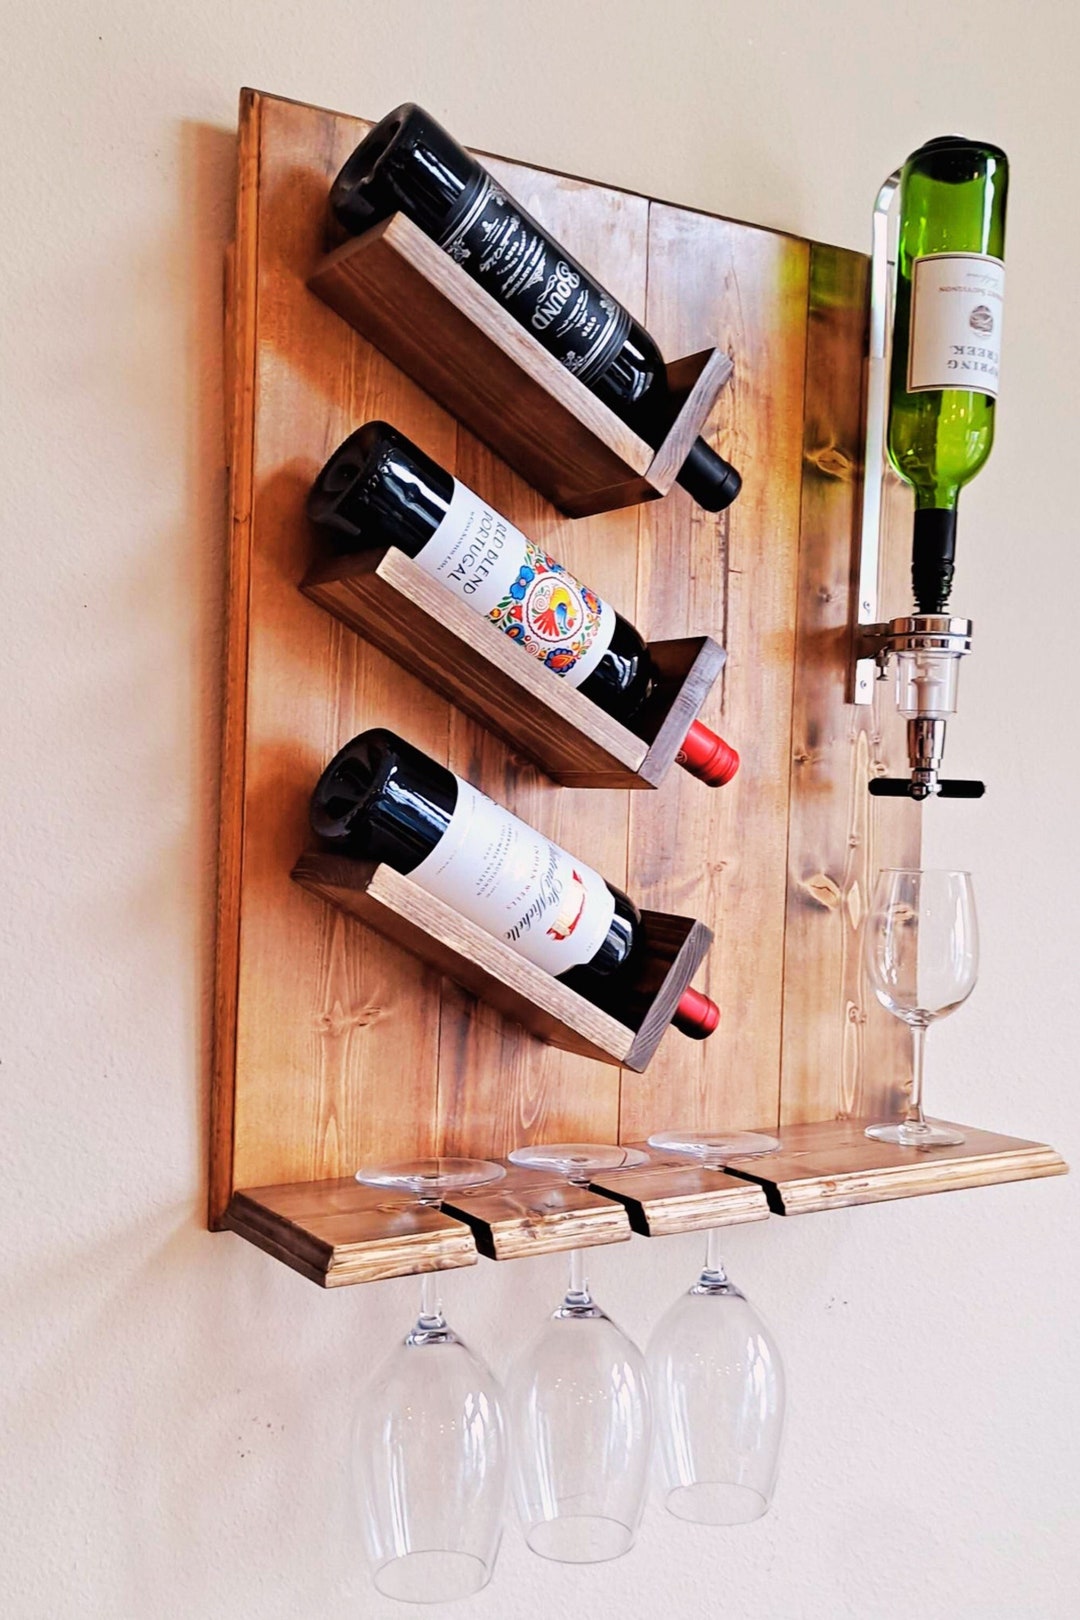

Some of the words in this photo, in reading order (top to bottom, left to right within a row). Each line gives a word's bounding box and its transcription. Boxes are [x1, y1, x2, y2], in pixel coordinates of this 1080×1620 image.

[529, 261, 579, 330] BOUND
[447, 510, 492, 581] PORTUGAL
[491, 521, 506, 550] RED
[462, 549, 498, 594] BLEND
[502, 873, 546, 941] Michelle
[504, 884, 530, 910] WELLS
